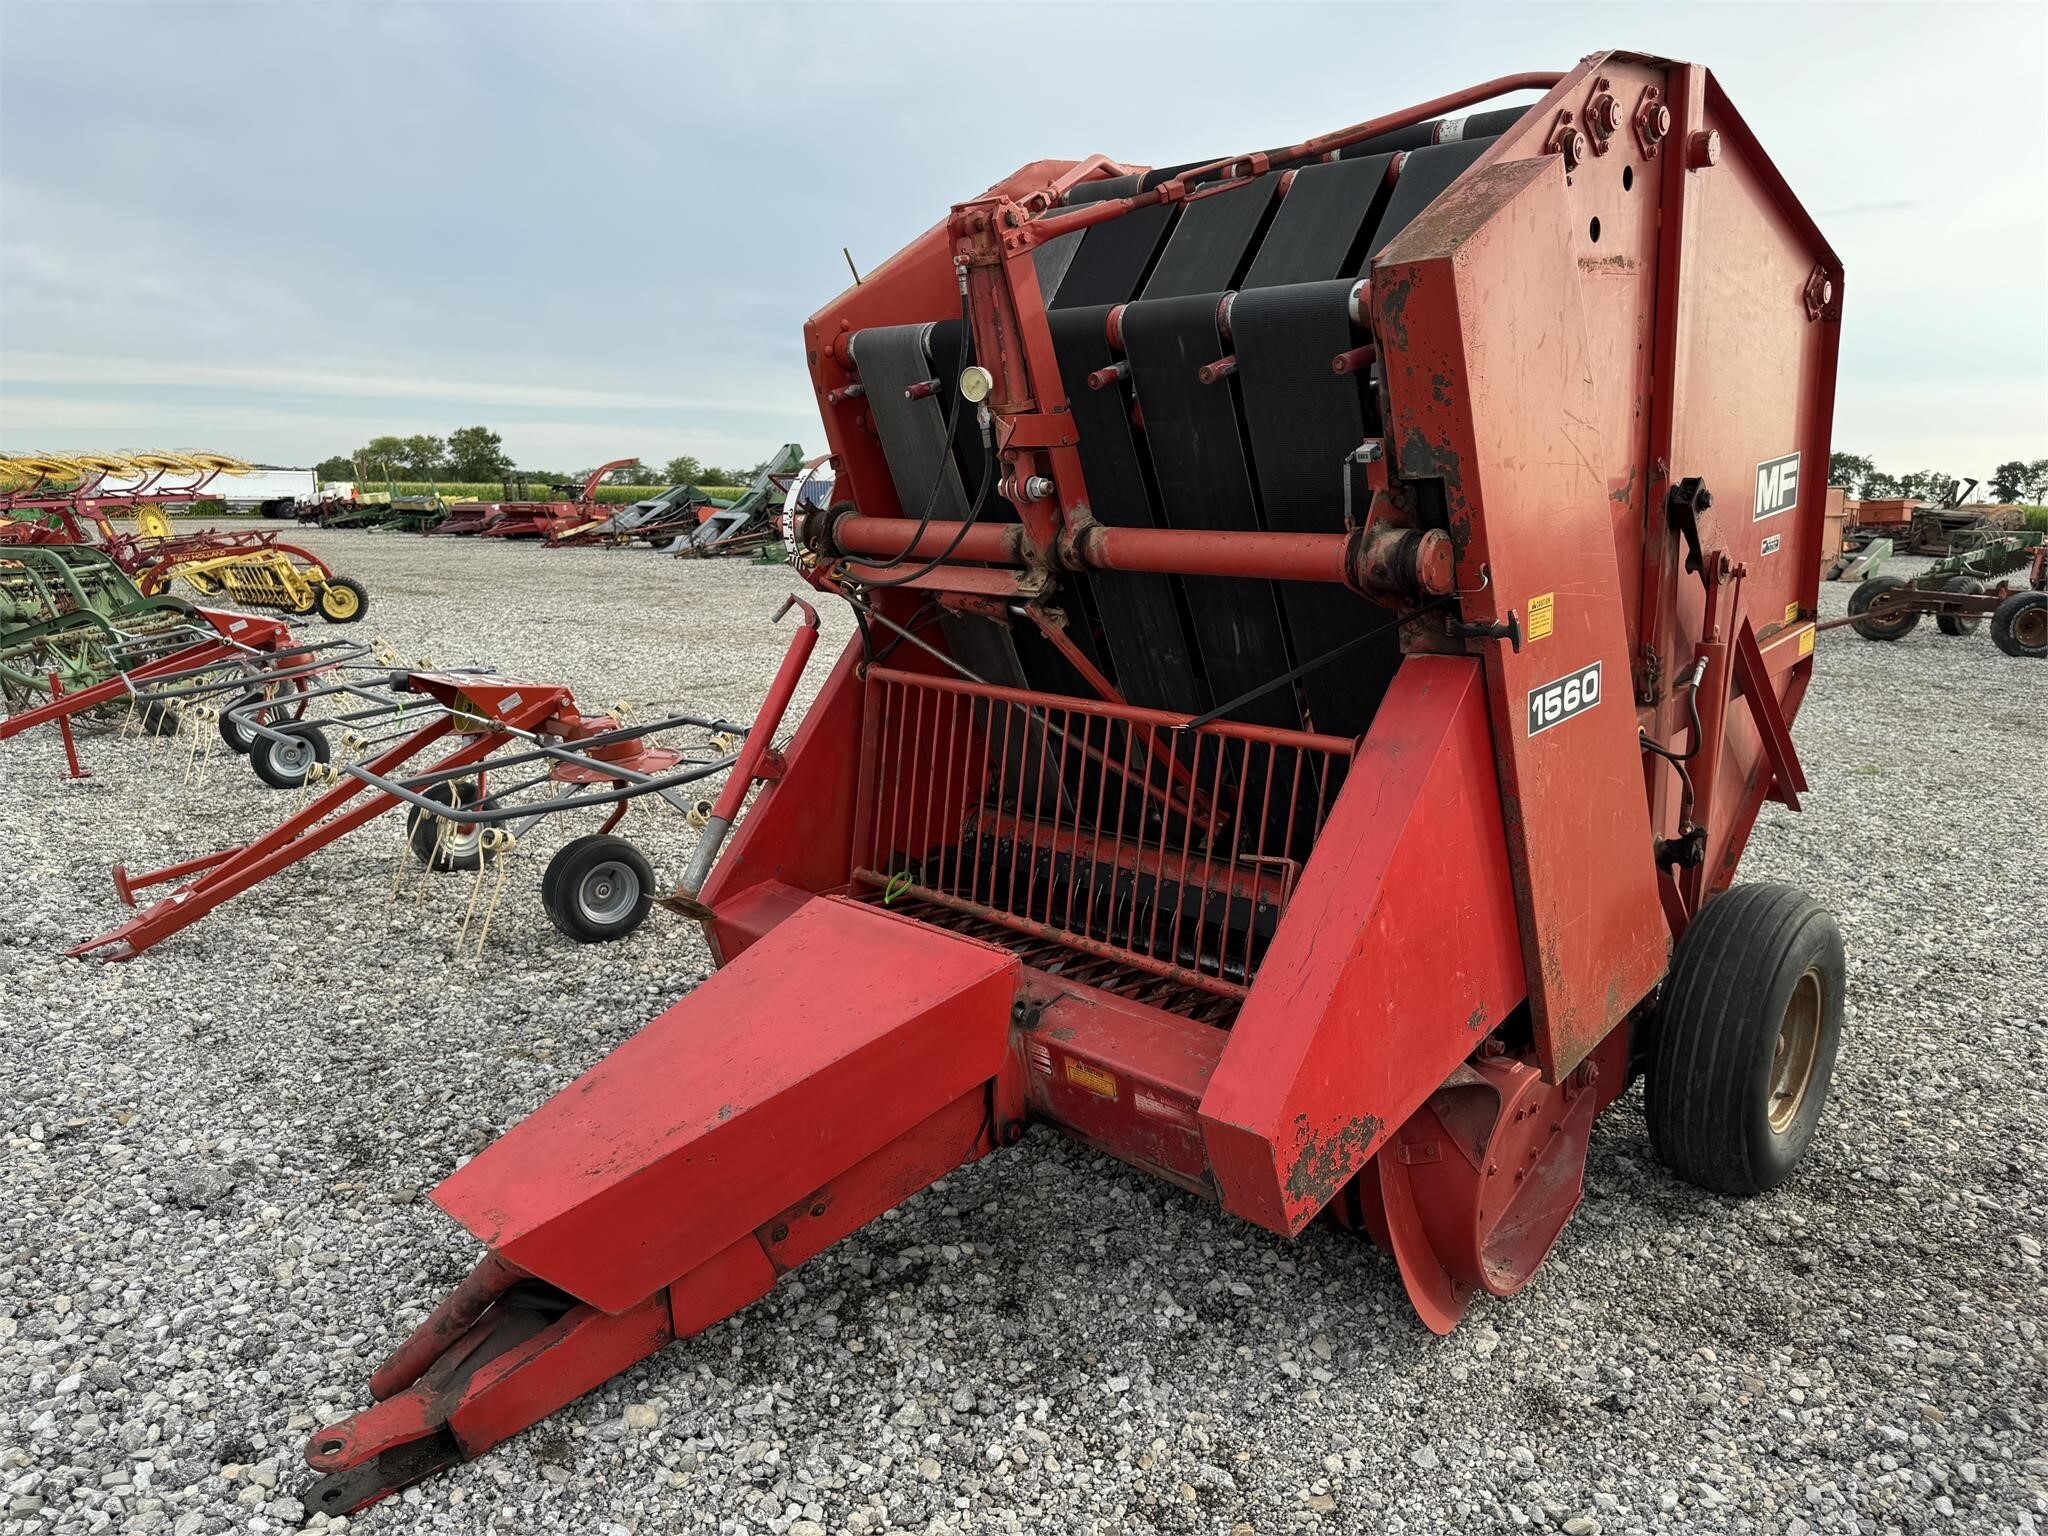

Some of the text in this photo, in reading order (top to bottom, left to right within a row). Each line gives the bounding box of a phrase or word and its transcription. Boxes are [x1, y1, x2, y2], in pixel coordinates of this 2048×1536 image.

[1756, 459, 1798, 514] MF
[788, 508, 793, 518] 3
[787, 521, 792, 530] 4
[789, 534, 794, 544] 5
[173, 550, 227, 563] NEW HOLLAND
[1532, 670, 1599, 726] 1560
